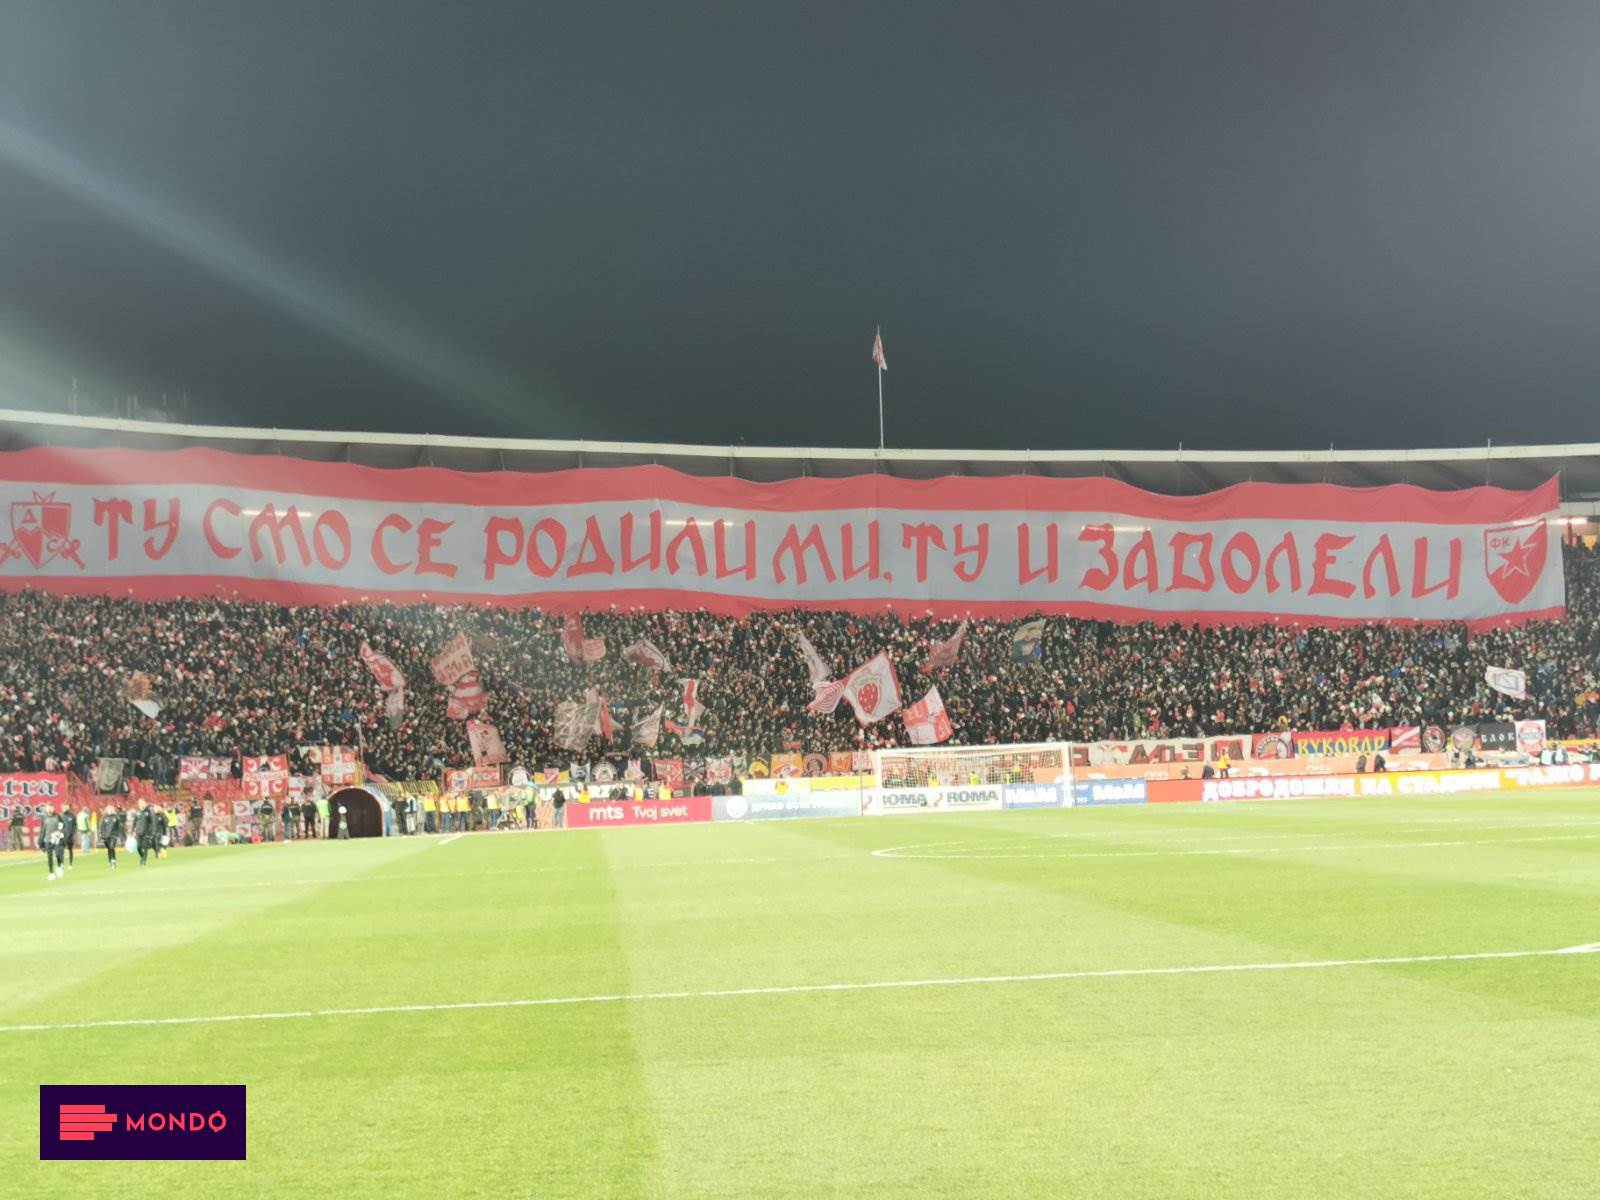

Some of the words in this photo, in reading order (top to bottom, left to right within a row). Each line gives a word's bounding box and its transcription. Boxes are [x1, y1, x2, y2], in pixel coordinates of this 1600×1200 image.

[92, 497, 180, 561] ТУ
[203, 499, 352, 570] СМО
[371, 513, 458, 578] СЕ
[482, 508, 756, 581] РОДИЛИ
[901, 521, 989, 583] ТУ
[1017, 521, 1059, 586] И
[1078, 522, 1463, 600] ЗАВОЛЕЛИ
[1490, 536, 1511, 550] ФК
[1297, 735, 1385, 756] ВУКОВАР
[946, 789, 999, 804] ROMA
[589, 805, 625, 820] mts
[632, 805, 658, 822] Tvoj
[660, 805, 687, 818] svet
